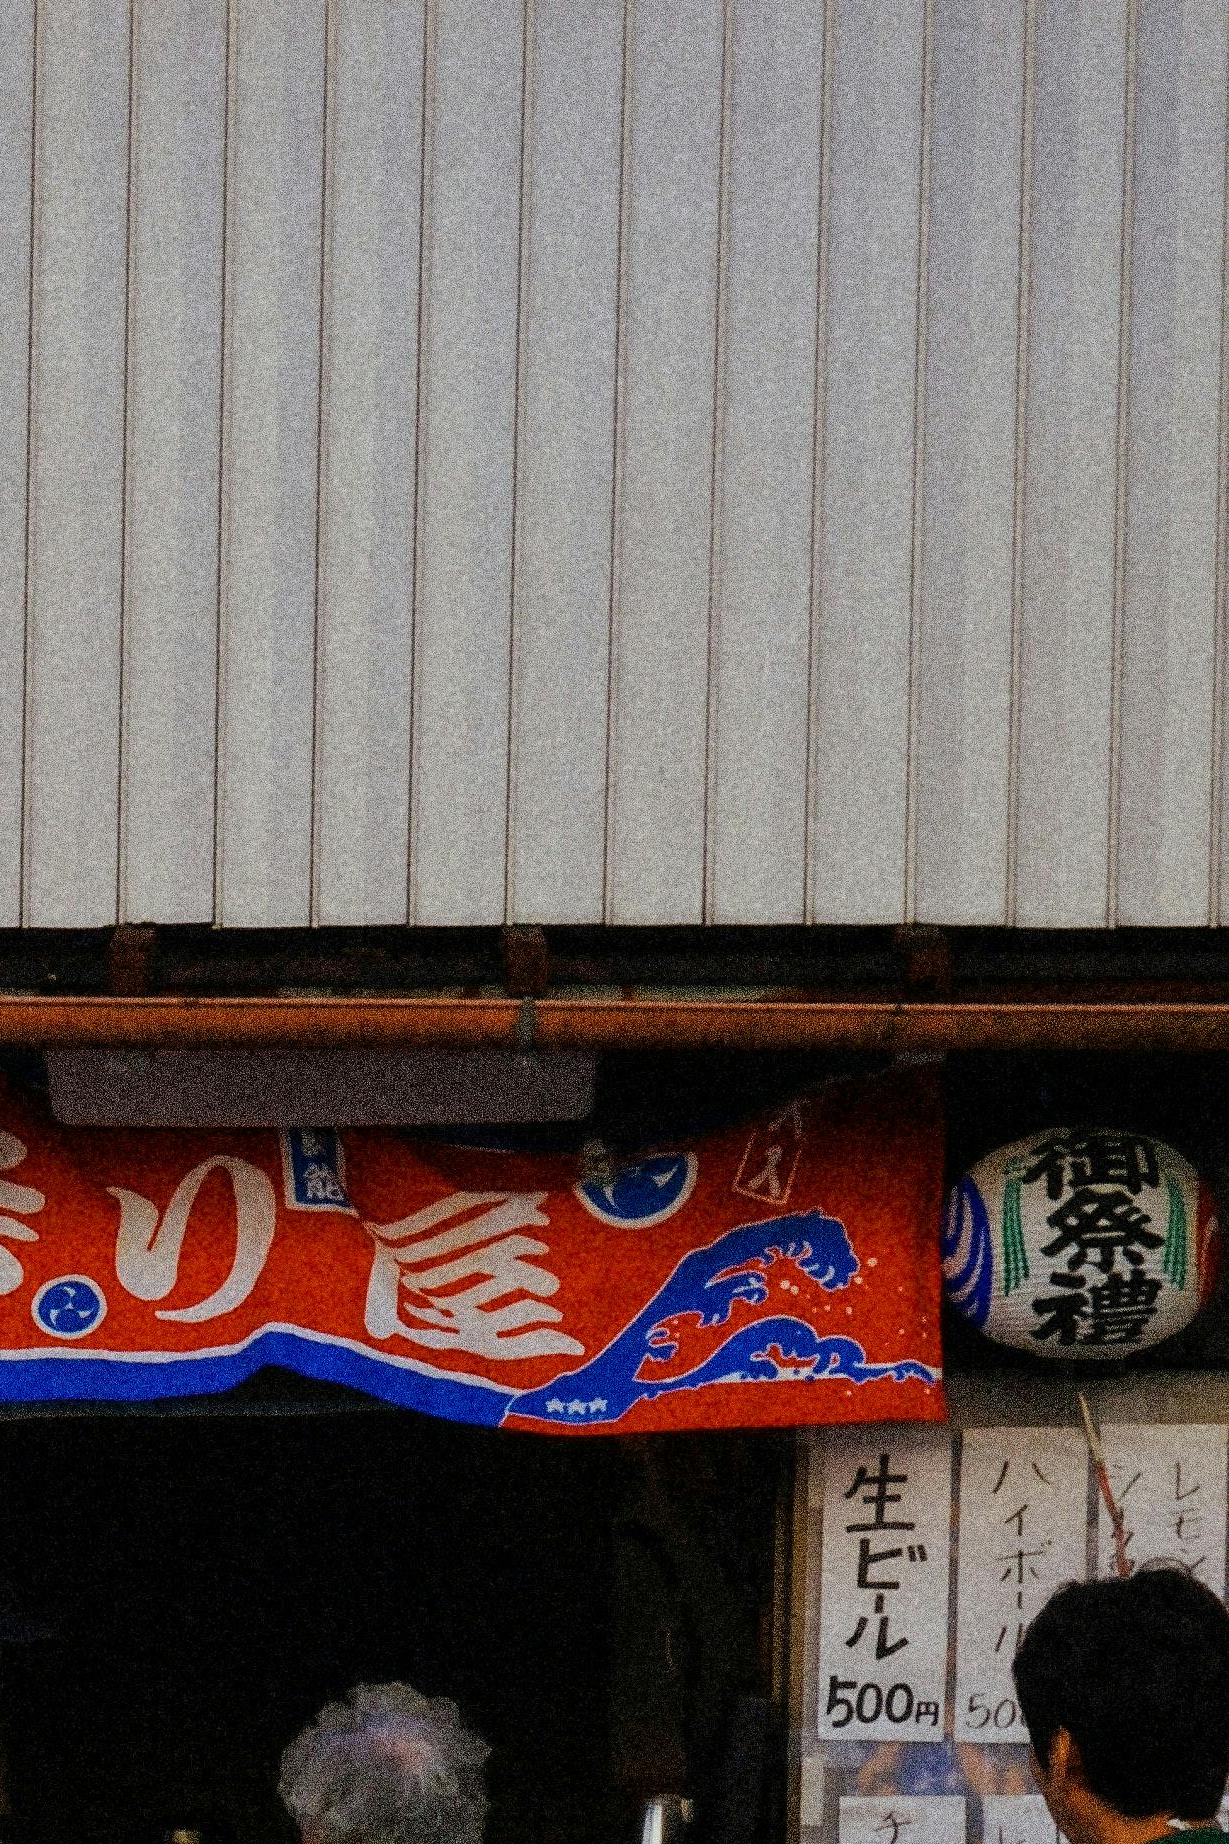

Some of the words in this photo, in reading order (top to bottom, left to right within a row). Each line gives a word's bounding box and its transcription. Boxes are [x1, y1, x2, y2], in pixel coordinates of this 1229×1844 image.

[1021, 1132, 1165, 1347] 御祭禮
[844, 1453, 929, 1661] 生ビール
[825, 1674, 941, 1730] 500円
[965, 1691, 1028, 1731] 50
